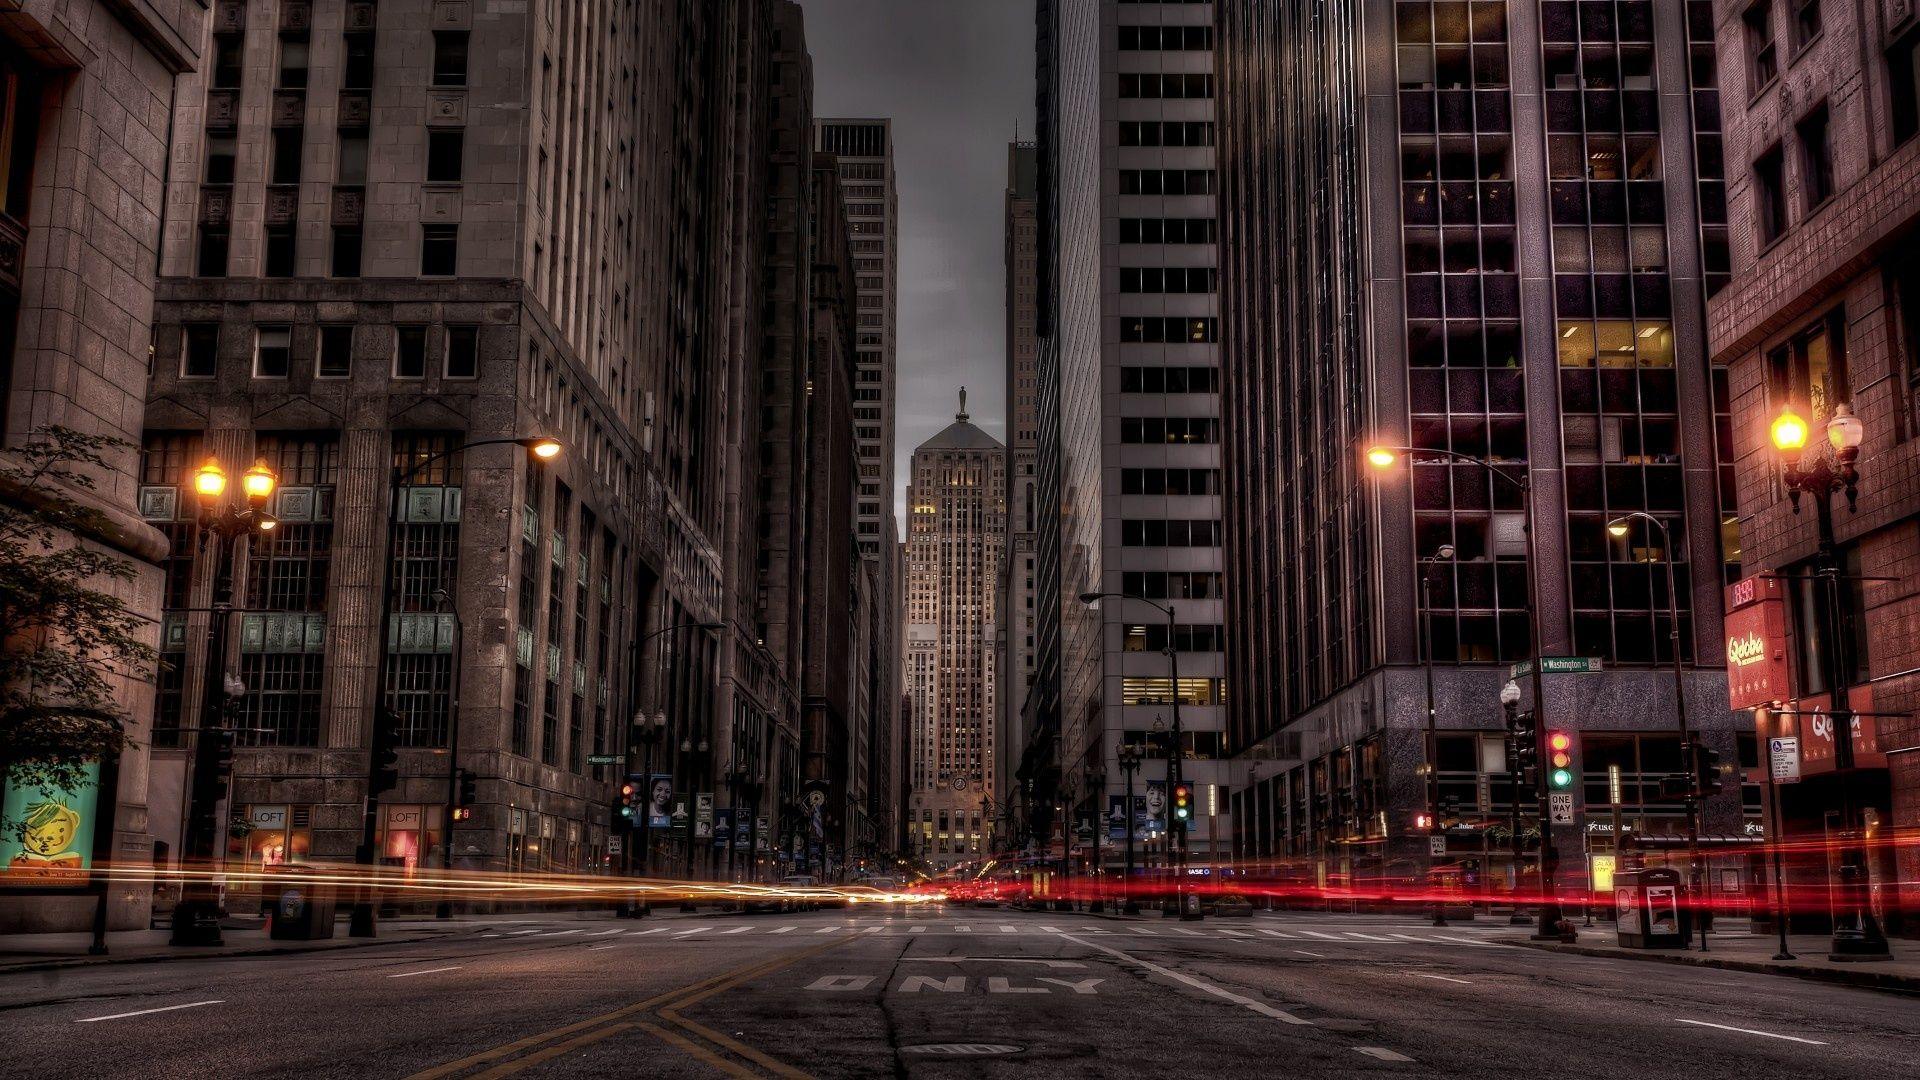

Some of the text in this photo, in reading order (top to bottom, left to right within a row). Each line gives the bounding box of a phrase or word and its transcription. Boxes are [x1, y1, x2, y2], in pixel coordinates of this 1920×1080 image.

[1728, 630, 1764, 667] Qdoba
[1548, 659, 1582, 672] Washington
[1552, 795, 1571, 804] ONE
[1552, 804, 1571, 812] WAY
[254, 812, 285, 822] LOFT
[390, 812, 419, 823] LOFT
[803, 974, 1106, 994] ONLY
